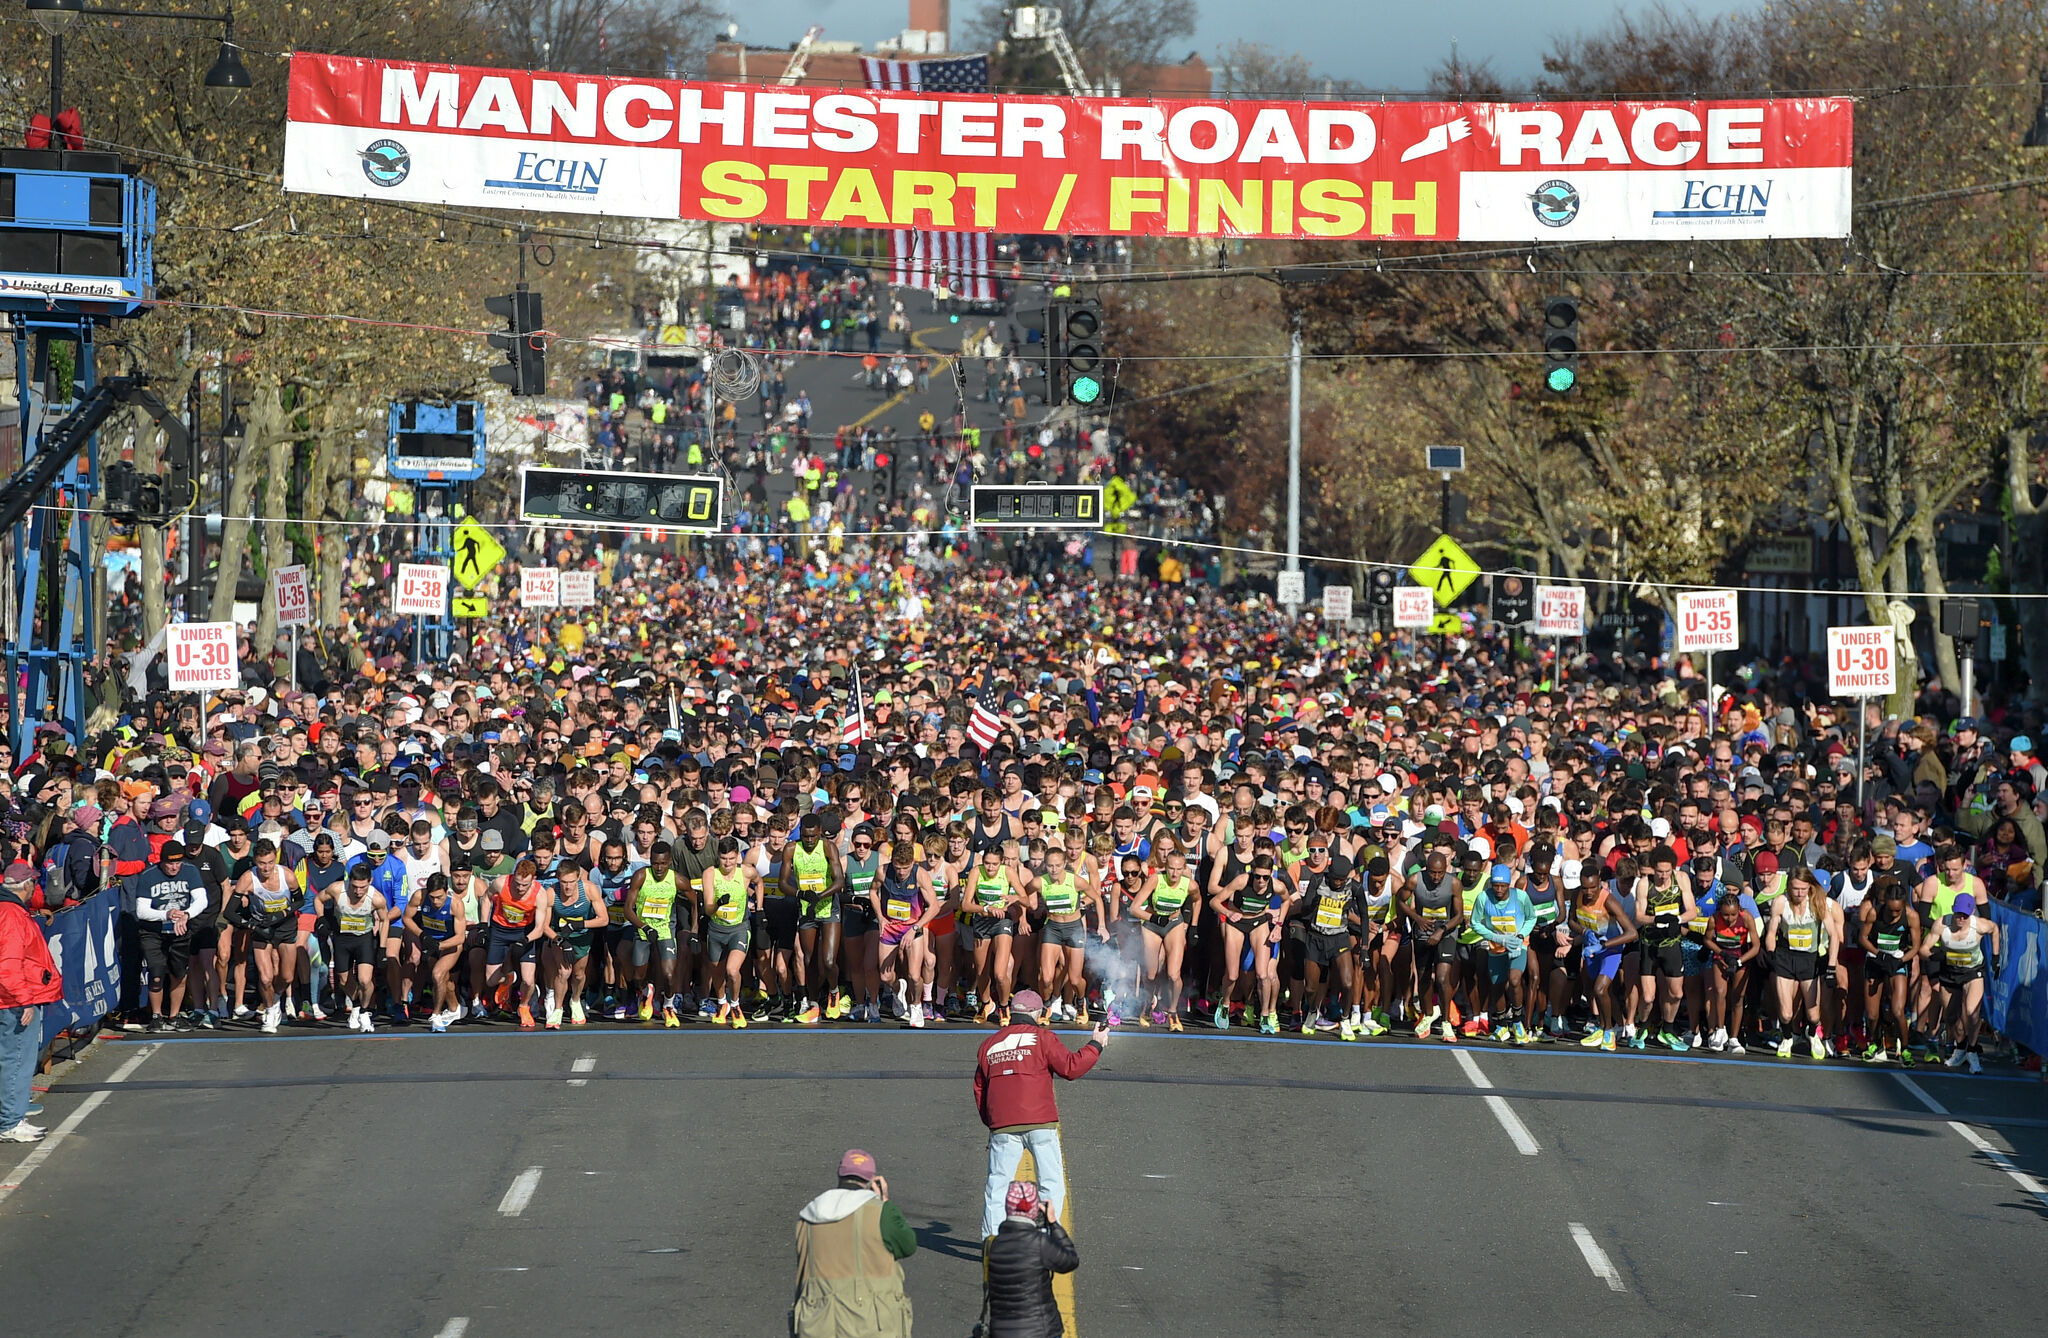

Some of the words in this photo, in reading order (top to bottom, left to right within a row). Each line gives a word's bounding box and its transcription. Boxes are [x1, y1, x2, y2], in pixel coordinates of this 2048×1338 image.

[380, 69, 1066, 158] MANCHESTER
[1101, 105, 1376, 164] ROAD
[1498, 107, 1764, 166] RACE
[482, 187, 506, 195] Eastern
[507, 189, 545, 198] Connecticut
[569, 194, 596, 202] Network
[700, 160, 1016, 228] START
[1043, 174, 1078, 230] /
[1109, 176, 1437, 236] FINISH
[1676, 218, 1713, 226] Connecticut
[1737, 217, 1765, 225] Network
[12, 280, 59, 292] United
[62, 282, 114, 295] Rentals
[279, 571, 300, 585] UNDER
[408, 568, 438, 579] UNDER
[404, 579, 441, 598] U-38
[526, 579, 554, 594] U-42
[278, 585, 305, 608] U-35
[525, 594, 555, 602] MINUTES
[1546, 591, 1575, 600] UNDER
[401, 598, 440, 609] MINUTES
[1400, 600, 1428, 613] U-42
[1541, 601, 1578, 619] U-38
[1690, 598, 1725, 609] UNDER
[279, 607, 306, 622] MINUTES
[1686, 611, 1731, 632] U-35
[1539, 619, 1578, 630] MINUTES
[181, 628, 222, 641] UNDER
[1684, 633, 1732, 645] MINUTES
[1841, 632, 1881, 645] UNDER
[176, 643, 229, 667] U-30
[1836, 648, 1888, 671] U-30
[175, 668, 231, 682] MINUTES
[1836, 673, 1889, 687] MINUTES
[151, 880, 190, 898] USMC
[1320, 896, 1347, 909] ARMY
[1326, 916, 1331, 924] 7
[994, 1049, 1032, 1058] MANCHESTER
